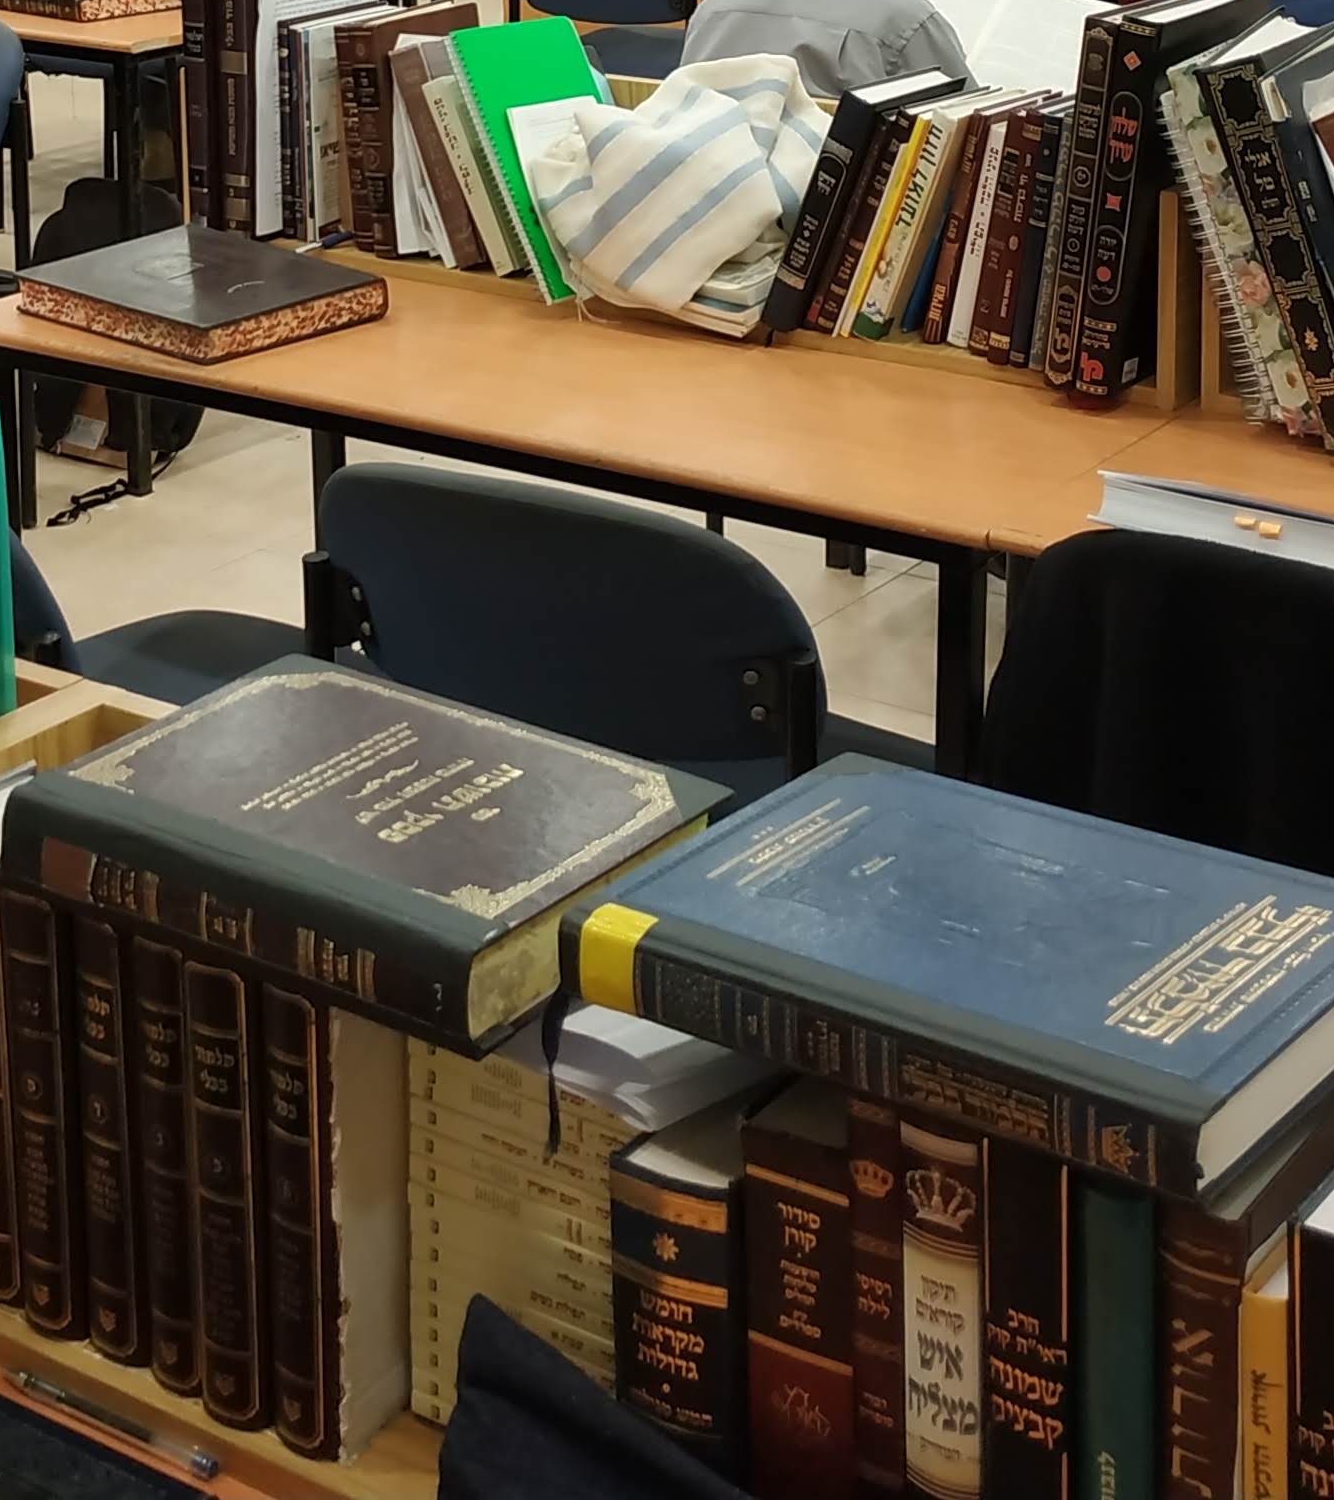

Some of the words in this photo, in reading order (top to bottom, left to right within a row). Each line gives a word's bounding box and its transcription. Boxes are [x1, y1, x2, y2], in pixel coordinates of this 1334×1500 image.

[922, 122, 945, 167] חזון
[895, 168, 930, 229] למועד
[378, 808, 439, 844] פסקי
[432, 762, 526, 818] תשובות
[1119, 940, 1259, 1045] תלמוד
[1227, 897, 1331, 960] בבלי
[777, 1201, 821, 1230] סידור
[783, 1223, 817, 1253] קורן
[856, 1272, 893, 1298] רסיסי
[920, 1273, 957, 1301] תיקון
[640, 1289, 693, 1324] חומש
[858, 1295, 890, 1320] לילה
[915, 1297, 965, 1337] קוראים
[1007, 1307, 1040, 1337] הרב
[631, 1312, 706, 1355] מקראות
[986, 1321, 1012, 1349] קוק
[636, 1341, 699, 1381] גדולות
[917, 1330, 964, 1382] איש
[988, 1355, 1065, 1407] שמונה
[907, 1374, 979, 1437] מצליח
[990, 1393, 1064, 1450] קבצים
[1170, 1317, 1215, 1499] אורות
[1250, 1369, 1284, 1436] אורות
[1296, 1425, 1326, 1456] קוק
